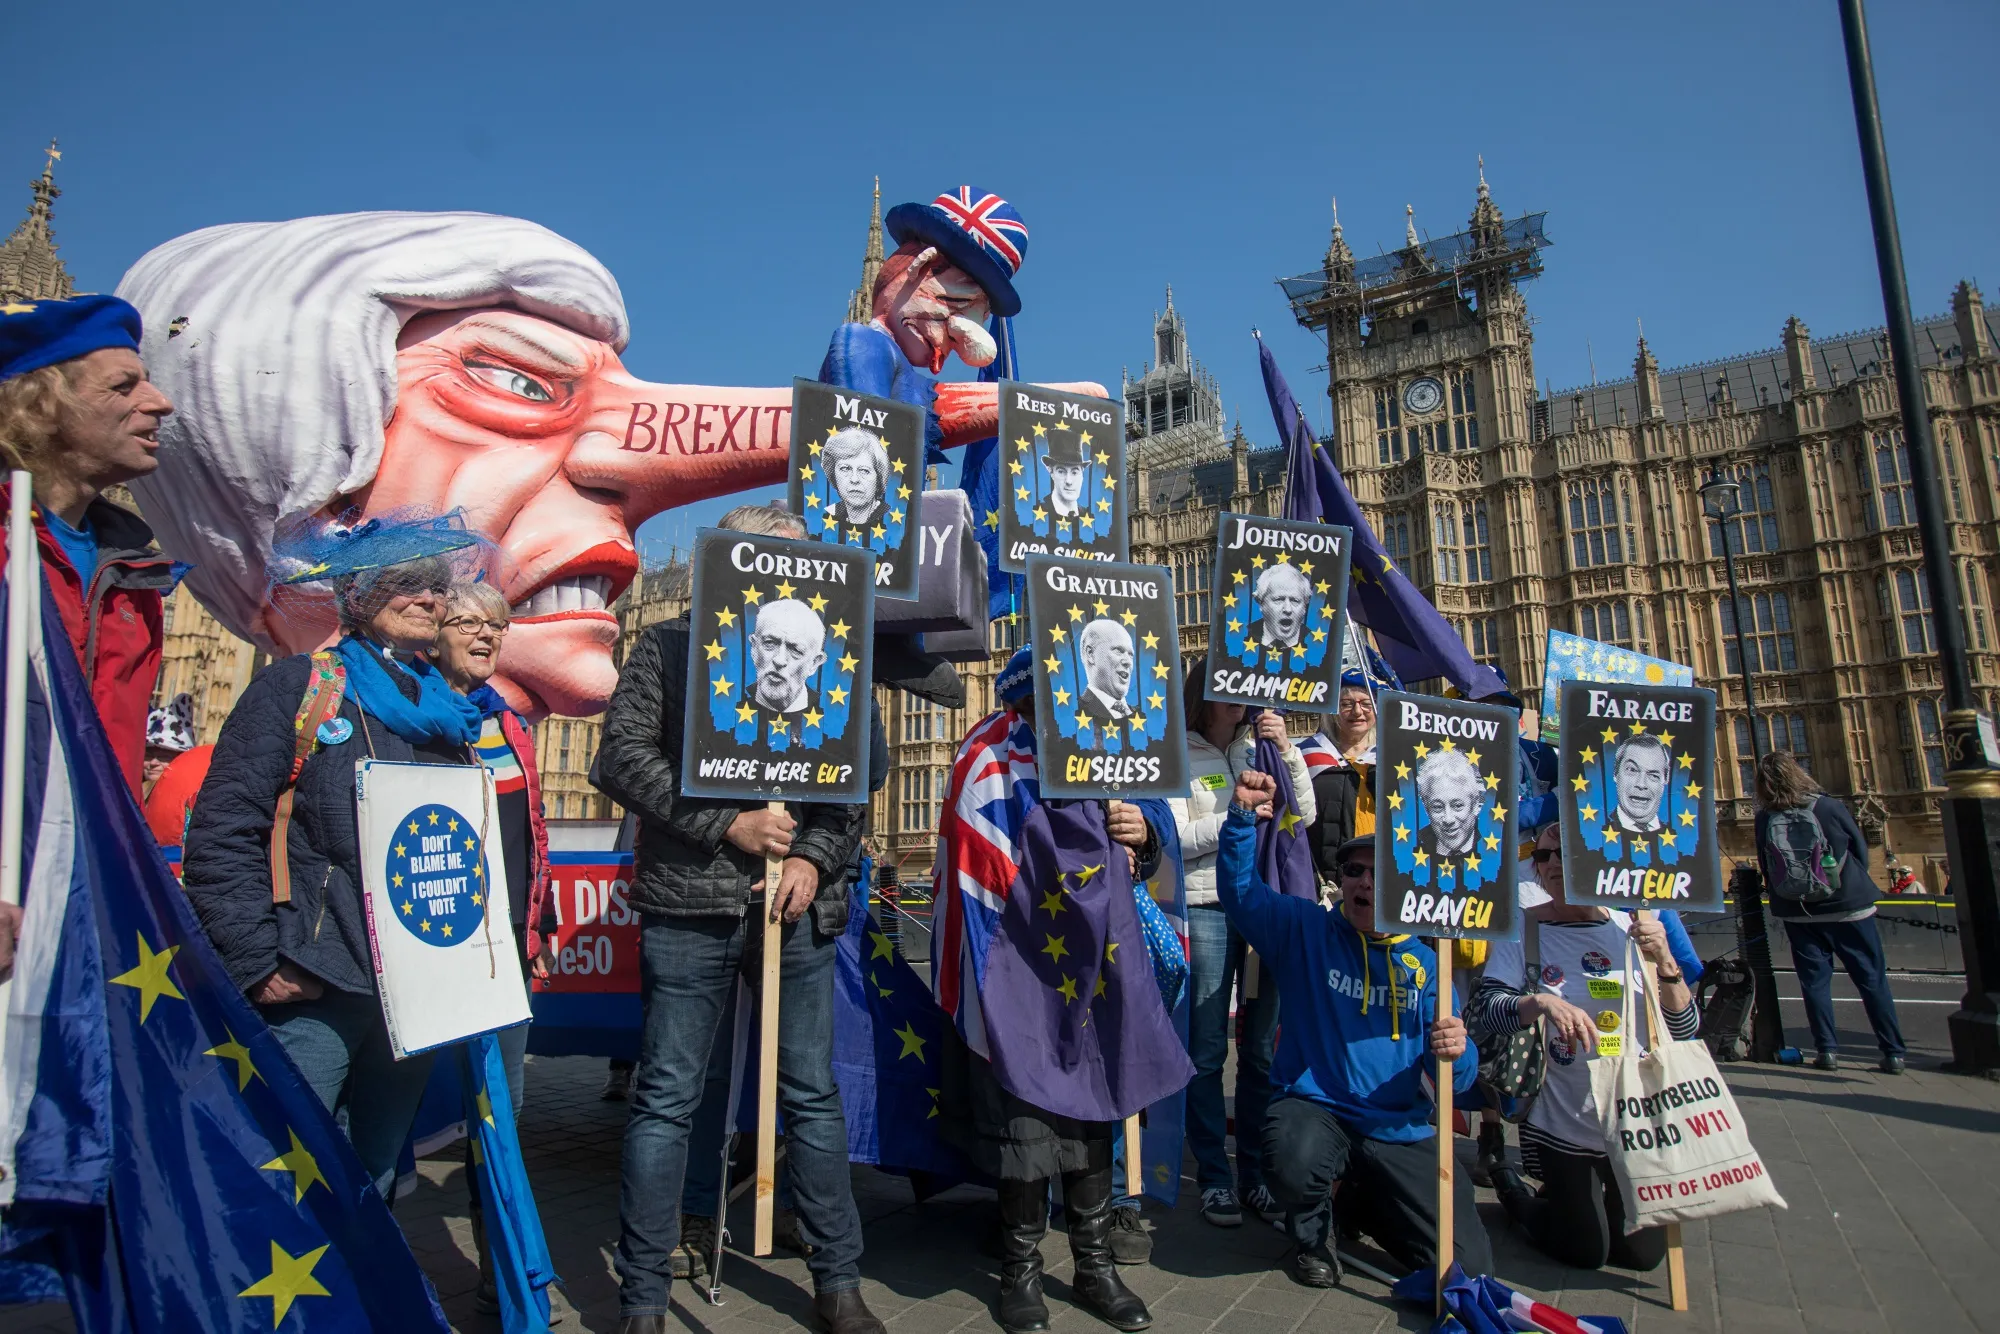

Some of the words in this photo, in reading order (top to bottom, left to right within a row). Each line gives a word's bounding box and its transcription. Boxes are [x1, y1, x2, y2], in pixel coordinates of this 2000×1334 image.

[619, 402, 791, 455] BREXIT
[1213, 669, 1329, 703] SCAMMEUR
[699, 757, 760, 780] WHERE
[763, 760, 812, 783] WERE
[817, 762, 853, 784] EU?
[1066, 754, 1161, 784] EUSELESS
[421, 834, 452, 854] DON'T
[410, 853, 446, 874] BLAME
[447, 852, 466, 871] ME.
[412, 882, 417, 900] I
[418, 876, 467, 898] COULDN'T
[1595, 866, 1692, 900] HATEUR
[428, 896, 457, 917] VOTE
[1400, 889, 1494, 929] BRAVEU
[1620, 1122, 1681, 1151] ROAD
[1685, 1109, 1732, 1139] W11
[1637, 1184, 1673, 1202] CITY
[1679, 1178, 1699, 1197] OF
[1703, 1160, 1763, 1191] LONDON
